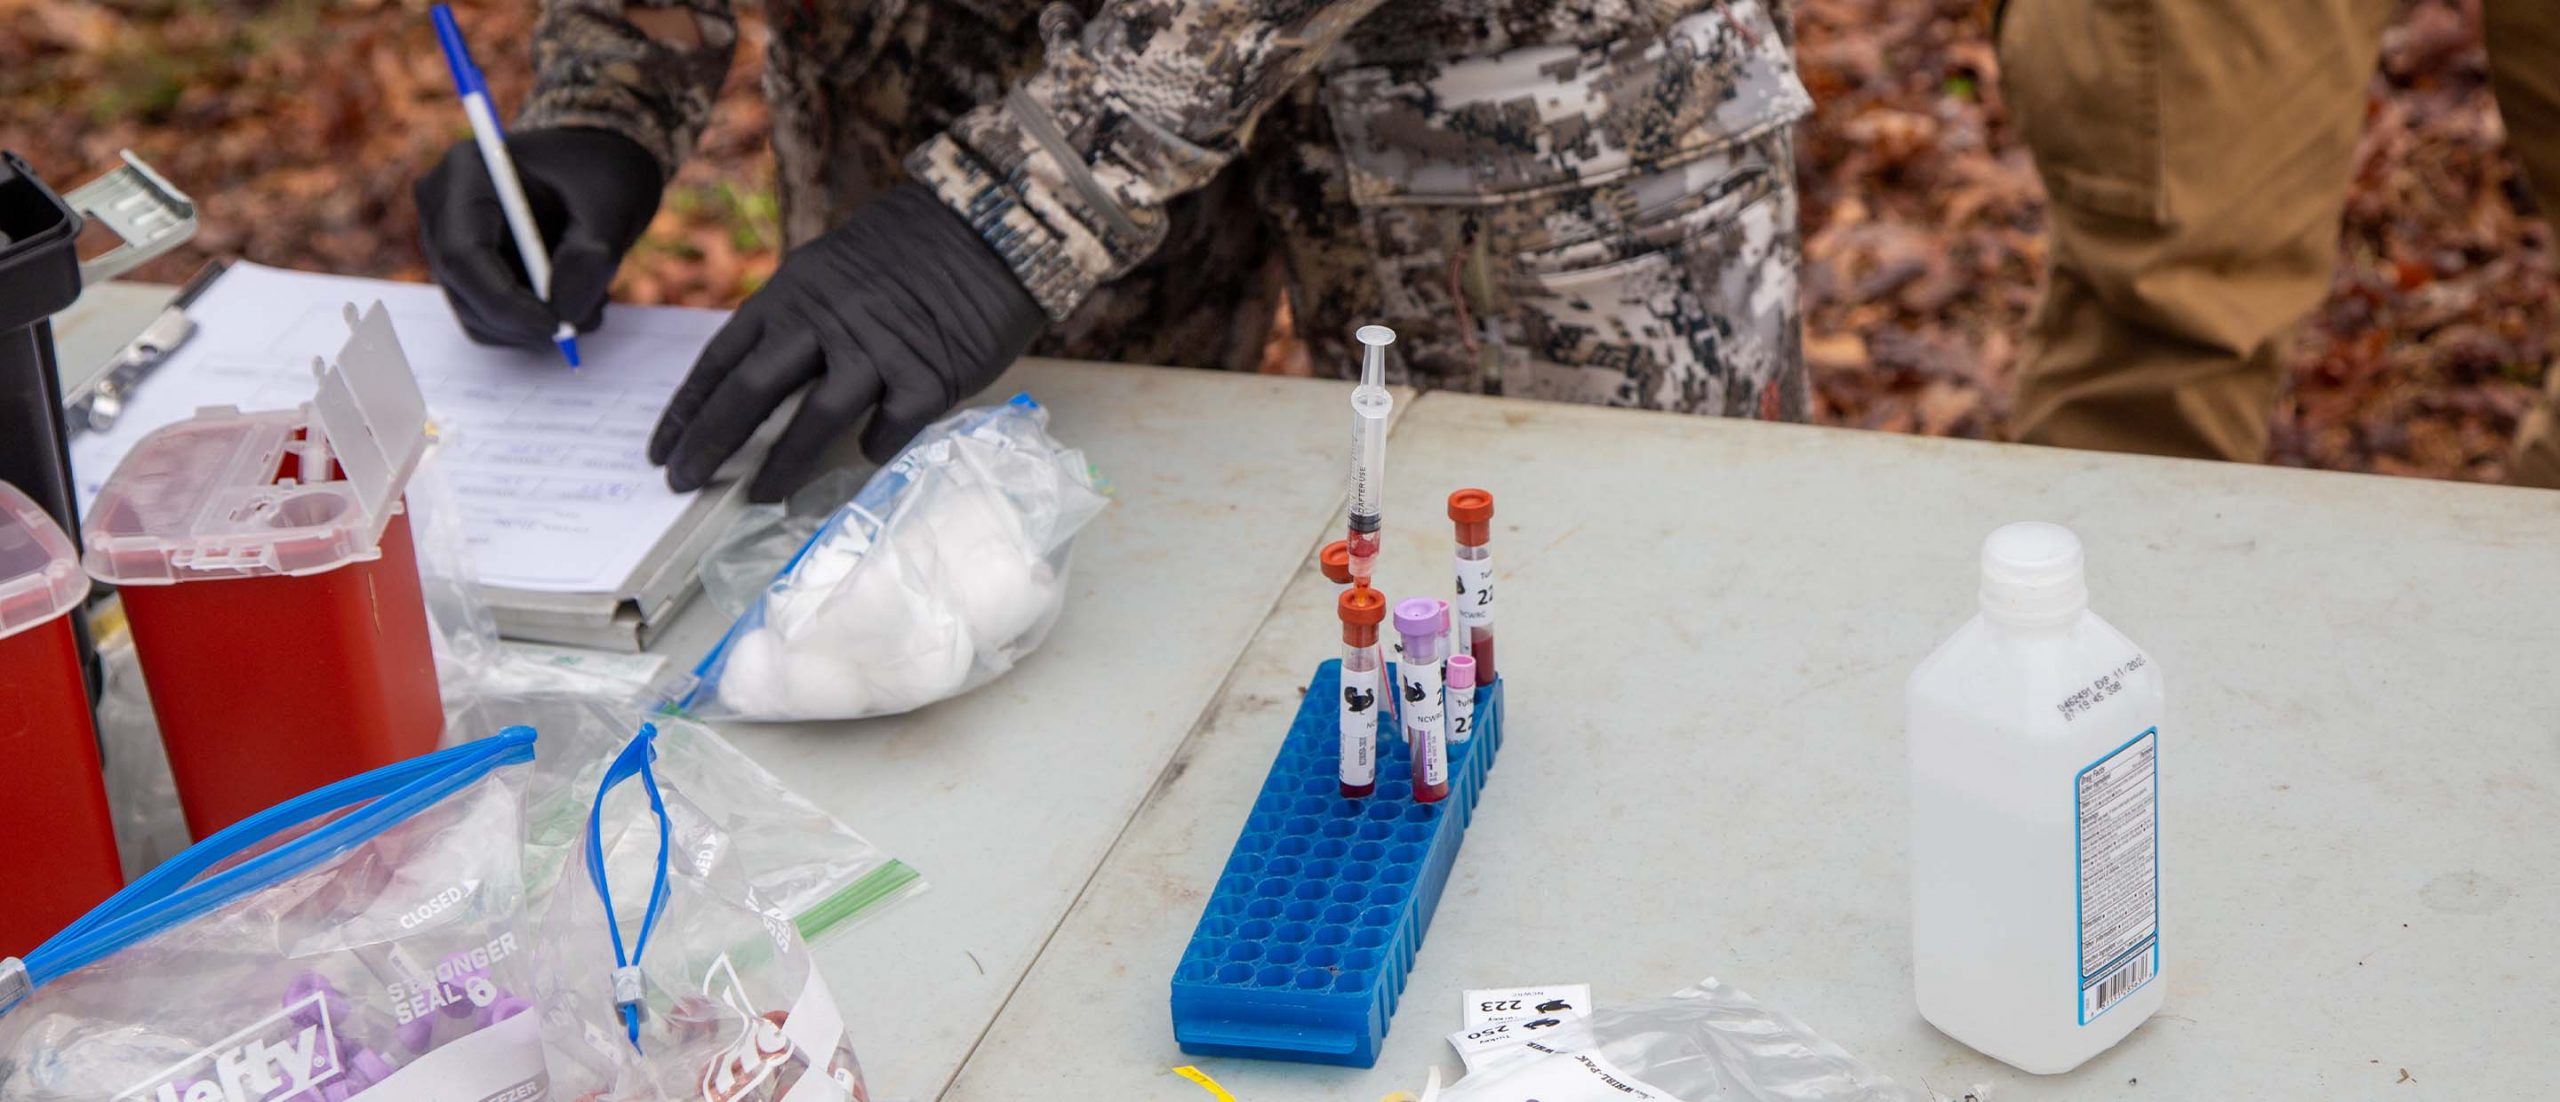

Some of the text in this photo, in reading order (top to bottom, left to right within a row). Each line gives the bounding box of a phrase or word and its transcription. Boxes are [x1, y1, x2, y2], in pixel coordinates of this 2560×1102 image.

[1358, 482, 1366, 507] AFTER
[400, 886, 462, 929] CLOSED
[394, 983, 464, 1025] SEAL
[1480, 999, 1522, 1012] 223
[1467, 1024, 1509, 1040] 250
[131, 1024, 317, 1102] efty
[1574, 1055, 1635, 1093] WHIRL-PAK
